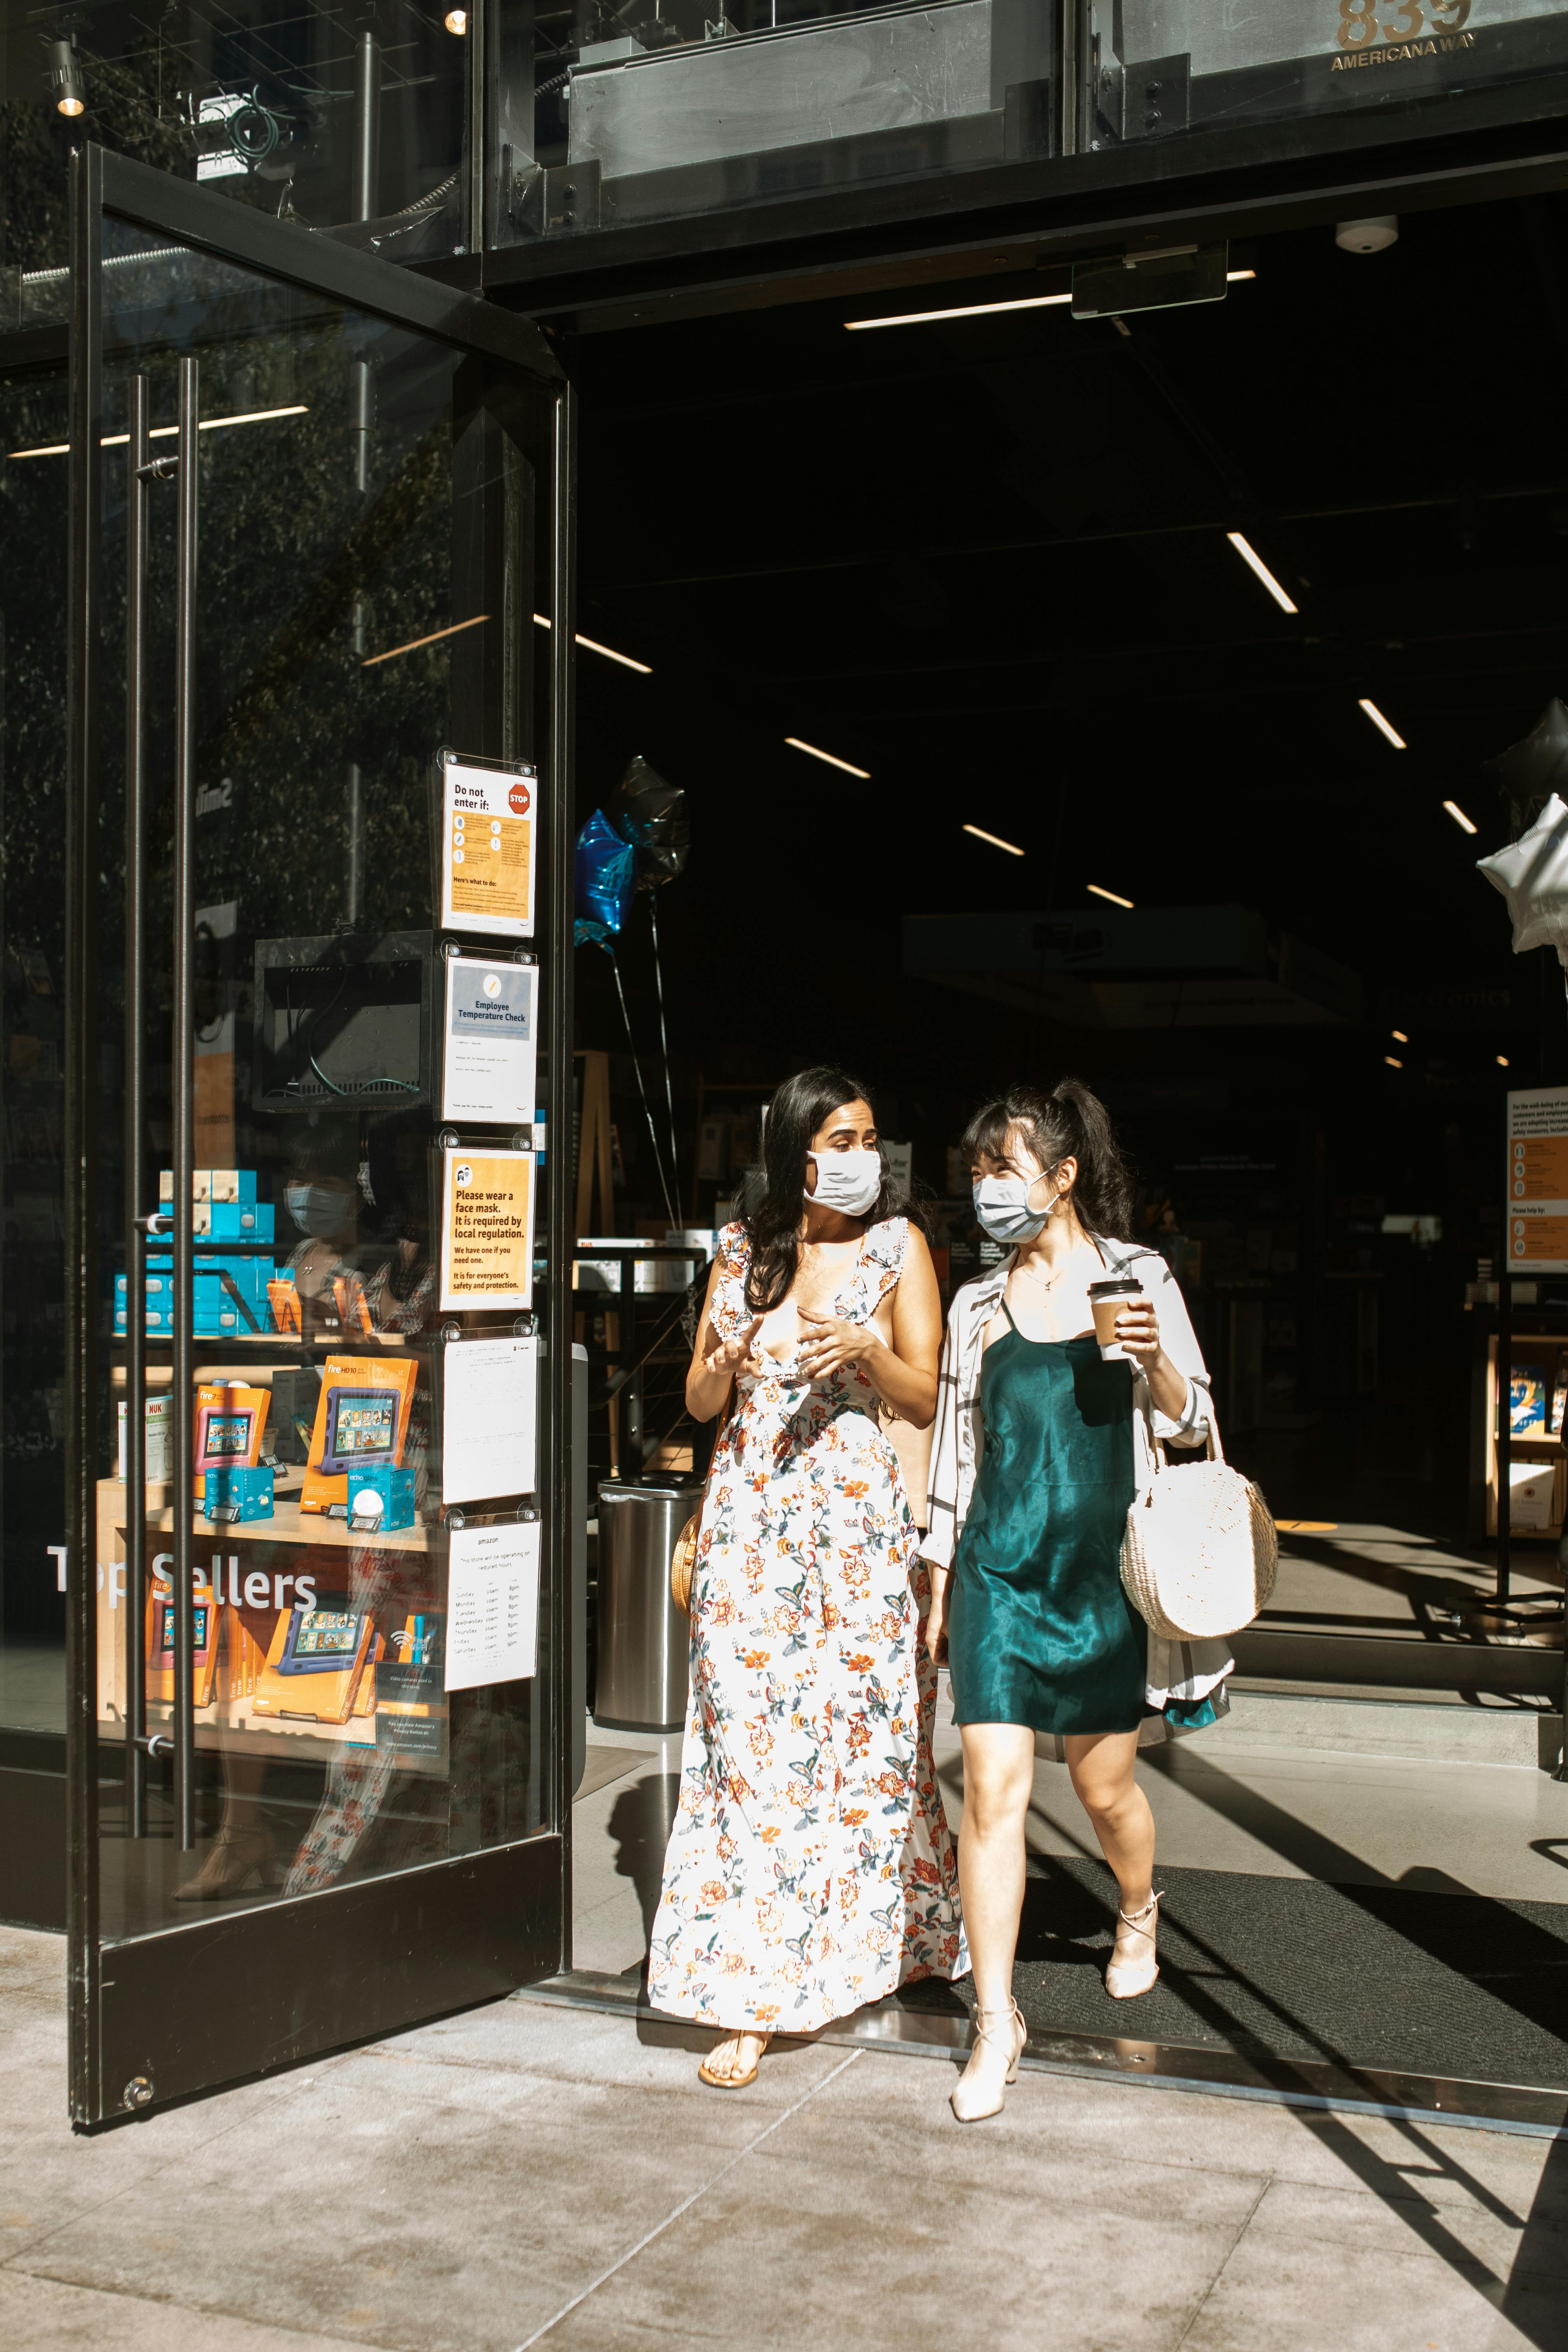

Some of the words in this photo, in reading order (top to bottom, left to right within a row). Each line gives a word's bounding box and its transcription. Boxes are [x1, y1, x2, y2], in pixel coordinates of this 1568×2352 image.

[1331, 41, 1437, 71] AMERICANA
[1440, 32, 1478, 53] WAY
[455, 784, 466, 795] Do
[469, 789, 484, 797] not
[510, 794, 528, 804] STOP
[455, 799, 478, 808] enter
[481, 800, 489, 810] if:
[476, 1001, 509, 1012] Employee
[459, 1010, 503, 1020] Temperature
[505, 1013, 525, 1022] Check
[1530, 1101, 1553, 1109] well-being
[1528, 1119, 1548, 1128] adopting
[456, 1190, 483, 1200] Please
[456, 1202, 473, 1212] face
[476, 1203, 501, 1213] mask.
[455, 1216, 462, 1225] It
[464, 1215, 471, 1225] is
[473, 1215, 509, 1228] required
[512, 1216, 522, 1228] by
[455, 1228, 476, 1238] local
[478, 1228, 524, 1240] regulation.
[477, 1272, 509, 1280] everyone's
[453, 1282, 471, 1290] safety
[486, 1281, 519, 1290] protection.
[328, 1364, 341, 1373] fire
[200, 1391, 212, 1400] fire
[149, 1404, 162, 1414] NUK
[154, 1580, 167, 1589] fire
[341, 1702, 349, 1717] fire
